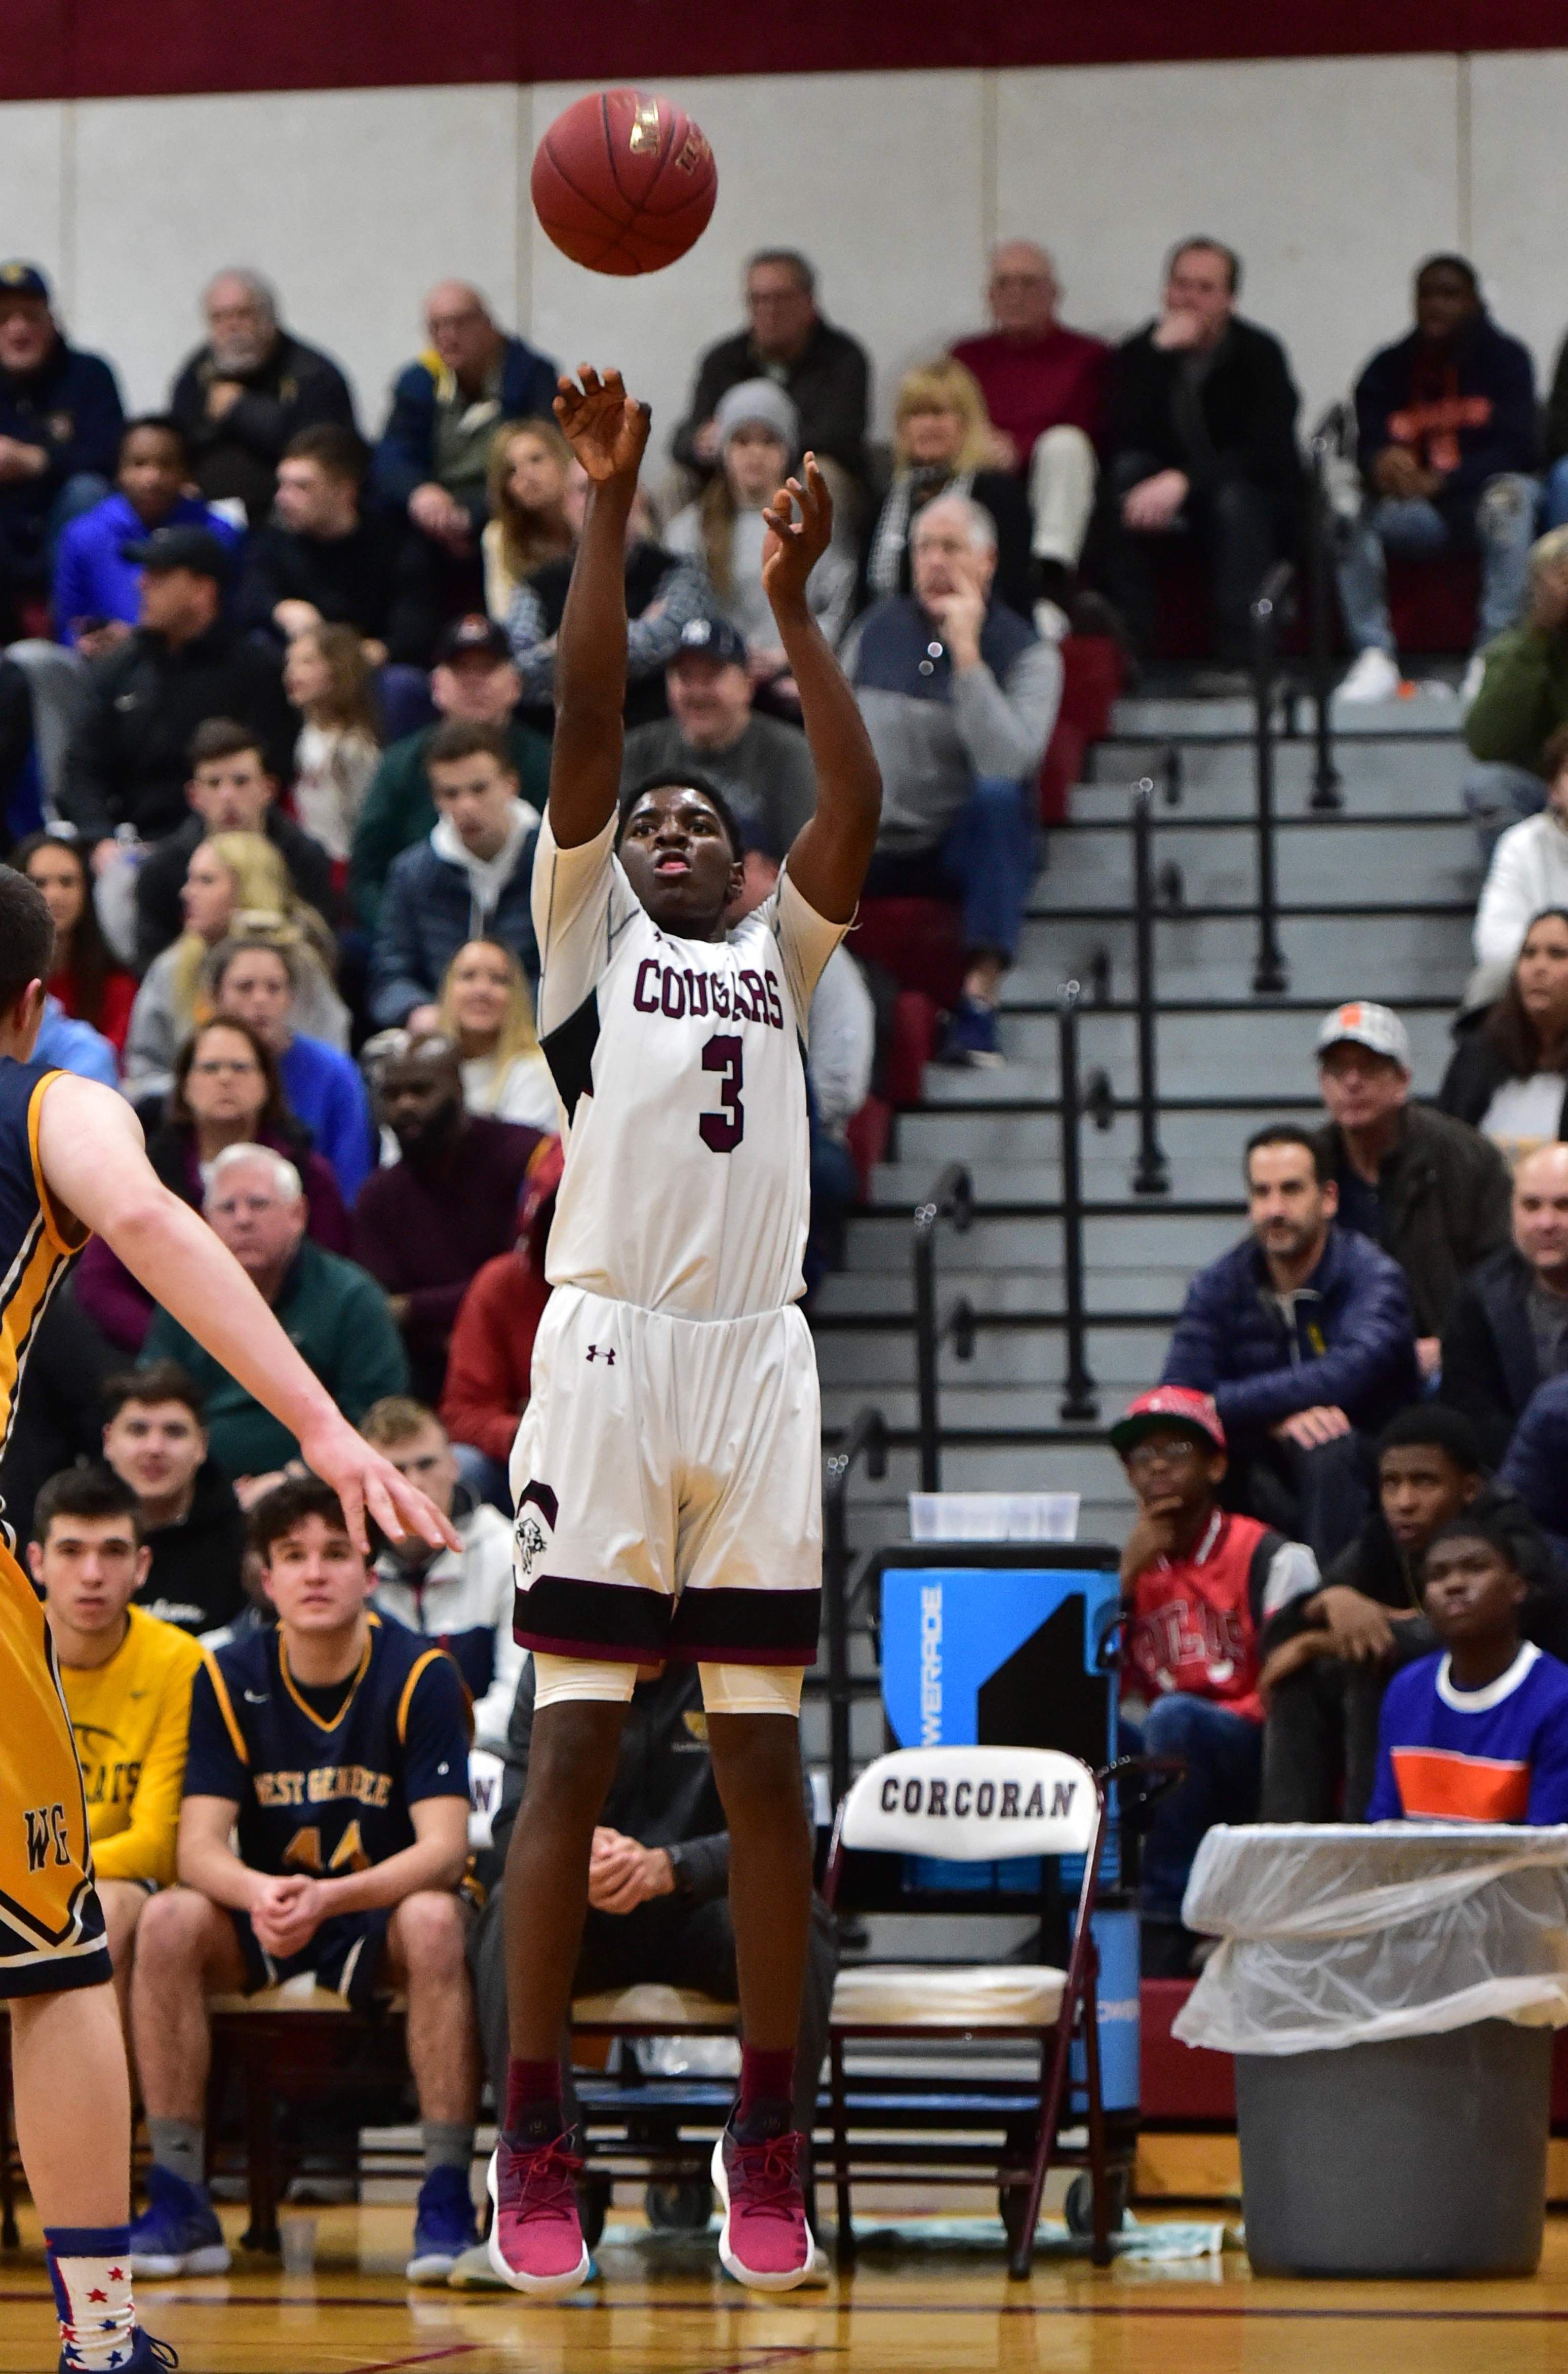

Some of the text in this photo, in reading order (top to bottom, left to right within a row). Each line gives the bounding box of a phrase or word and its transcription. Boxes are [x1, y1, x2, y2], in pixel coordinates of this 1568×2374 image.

[633, 958, 784, 1029] COUGARS
[699, 1035, 743, 1153] 3
[921, 1582, 942, 1746] WERADE
[880, 1777, 1077, 1819] CORCORAN
[23, 1803, 70, 1873] WG
